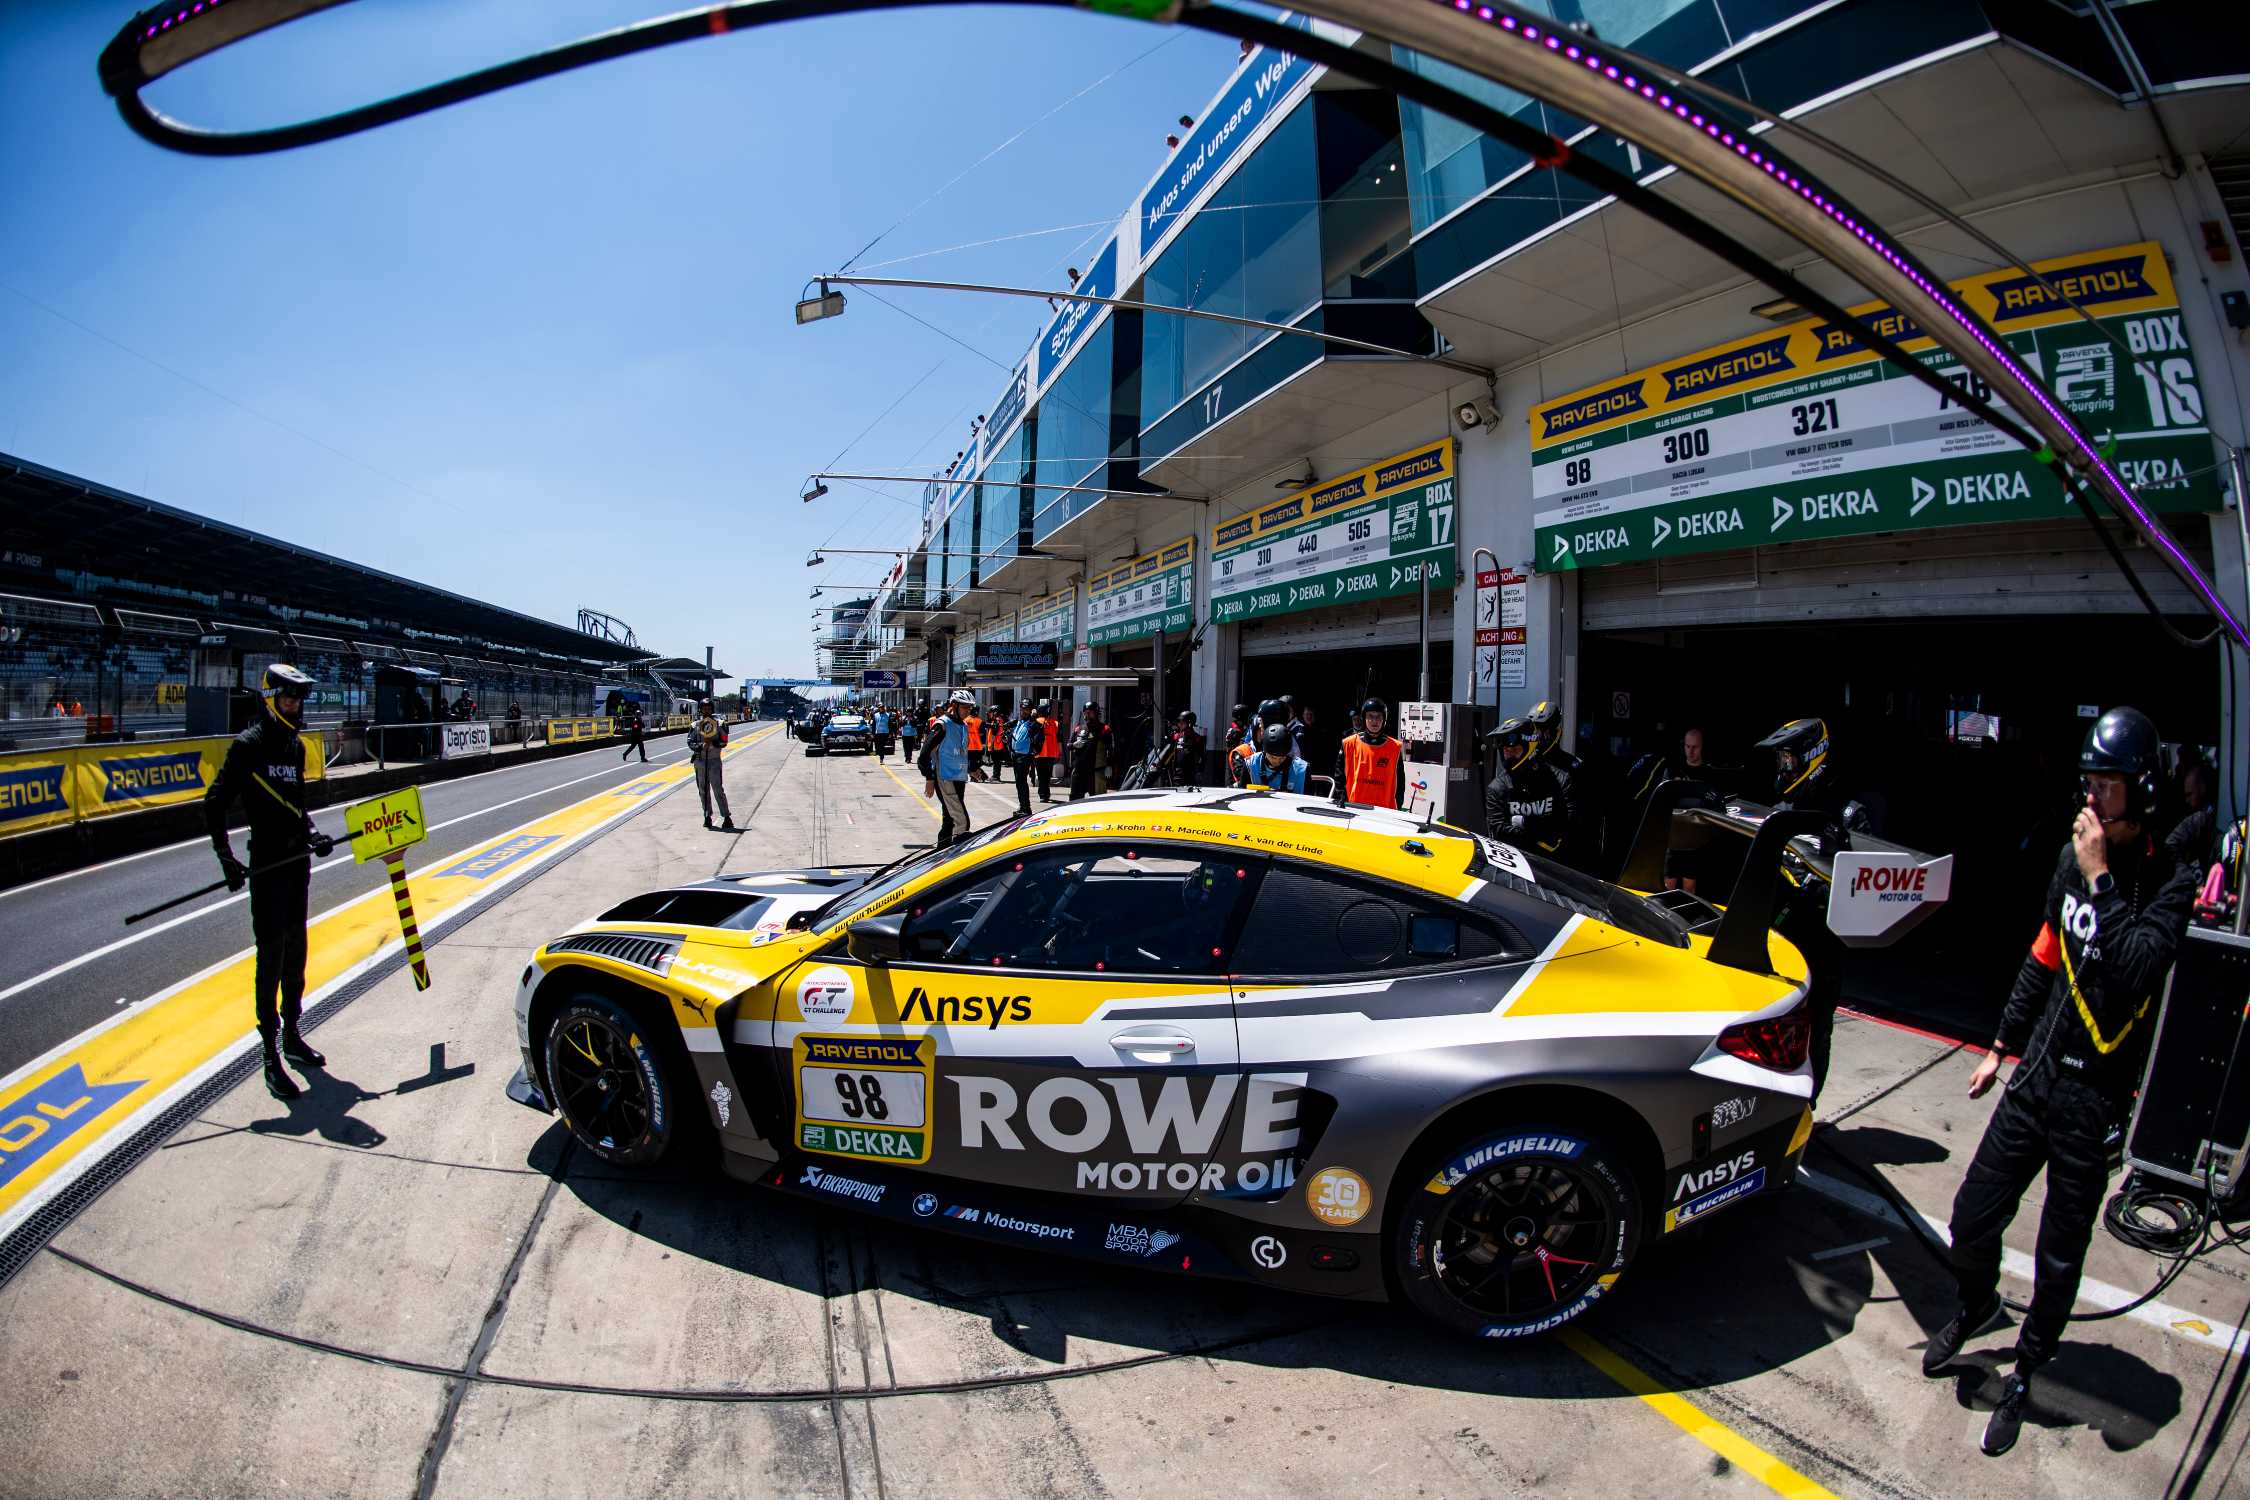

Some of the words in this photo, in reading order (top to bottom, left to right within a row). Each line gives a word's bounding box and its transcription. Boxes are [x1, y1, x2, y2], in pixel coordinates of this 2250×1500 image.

[1148, 187, 1179, 230] Autos
[1180, 144, 1206, 191] sind
[1207, 96, 1253, 157] unsere
[2124, 315, 2188, 354] BOX
[1550, 391, 1637, 430] RAVENOL
[1674, 349, 1781, 391] RAVENOL
[2003, 269, 2139, 309] RAVENOL
[1203, 385, 1222, 424] 17
[2134, 357, 2202, 427] 16
[1791, 398, 1840, 436] 321
[1663, 428, 1710, 464] 300
[1565, 457, 1591, 486] 98
[1219, 523, 1250, 540] RAVENOL
[1262, 505, 1300, 525] RAVENOL
[1315, 484, 1361, 507] RAVENOL
[1380, 459, 1438, 485] RAVENOL
[1426, 482, 1453, 507] BOX
[1574, 526, 1630, 554] DEKRA
[1678, 507, 1744, 538] DEKRA
[1802, 488, 1879, 521] DEKRA
[1945, 470, 2031, 505] DEKRA
[2119, 458, 2190, 490] EKRA
[1061, 503, 1070, 521] 18
[1348, 518, 1371, 542] 505
[1428, 504, 1454, 546] 17
[1298, 534, 1317, 554] 440
[16, 553, 43, 568] POWER
[1222, 559, 1234, 576] 187
[1257, 548, 1272, 566] 310
[1181, 564, 1192, 578] BOX
[1484, 572, 1515, 584] CAUION
[1181, 579, 1192, 603] 18
[1224, 600, 1243, 614] DEKRA
[1258, 592, 1281, 609] DEKRA
[1299, 583, 1326, 602] DEKRA
[1347, 573, 1378, 593] DEKRA
[1404, 561, 1441, 583] DERA
[166, 685, 186, 701] ADA
[447, 724, 487, 749] Capristo
[112, 762, 197, 791] RAVENOL
[267, 764, 297, 778] ROWE
[0, 778, 57, 806] ENOL
[1509, 797, 1553, 816] ROWE
[364, 810, 403, 835] ROWE
[1177, 826, 1222, 838] Marciello
[1243, 834, 1253, 842] K.
[1256, 838, 1274, 846] van
[1277, 840, 1293, 849] der
[1296, 843, 1324, 856] Linde
[1856, 867, 1929, 891] ROWE
[1879, 893, 1909, 902] MOTOR
[812, 1007, 846, 1015] CHALLENGE
[898, 987, 1032, 1031] Ansys
[812, 1043, 914, 1061] RAVENOL
[2060, 1053, 2085, 1070] Jarek
[834, 1073, 889, 1121] 98
[944, 1072, 1309, 1154] ROWE
[834, 1129, 916, 1158] DEKRA
[1463, 1136, 1577, 1171] MICHELIN
[1076, 1161, 1226, 1191] MOTOR
[1236, 1157, 1297, 1191] OIL
[1673, 1150, 1755, 1201] Ansys
[1695, 1179, 1755, 1213] MICHELIN
[1317, 1206, 1360, 1218] YEARS
[983, 1211, 1076, 1240] Motorsport
[1107, 1223, 1150, 1239] MBA
[1104, 1240, 1148, 1255] SPORT
[1106, 1234, 1149, 1247] MOTOR
[1484, 1299, 1588, 1338] MICHELIN
